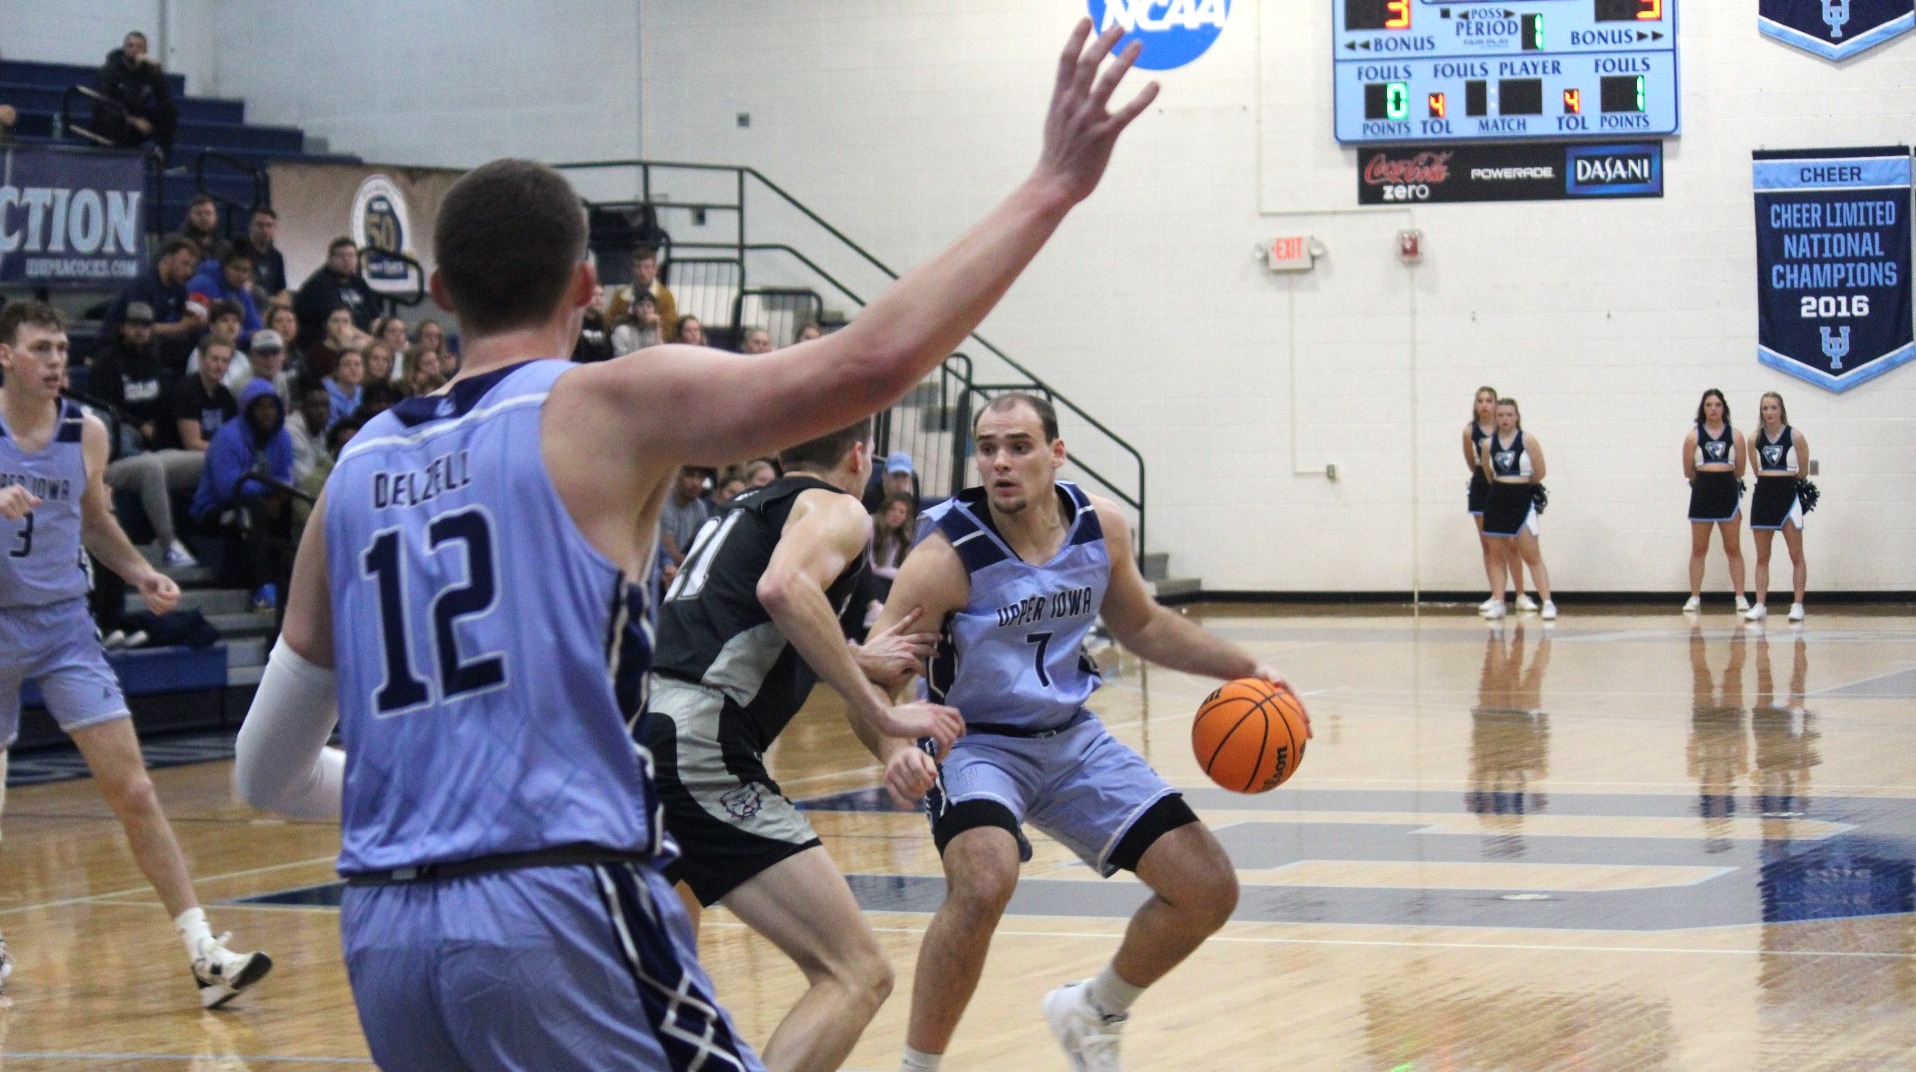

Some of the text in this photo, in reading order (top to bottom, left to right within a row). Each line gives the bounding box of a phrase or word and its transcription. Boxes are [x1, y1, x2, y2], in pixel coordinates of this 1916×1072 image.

[1101, 0, 1226, 33] NCAA
[1471, 8, 1501, 20] POSS
[1455, 20, 1518, 36] PERIOD
[1534, 14, 1543, 49] 1
[1570, 29, 1633, 45] BONUS
[1373, 36, 1435, 51] BONUS
[1357, 65, 1412, 80] FOULS
[1433, 60, 1562, 78] FOULS PLAYER
[1594, 57, 1650, 73] FOULS
[1387, 82, 1408, 120] 0
[1429, 93, 1445, 117] 4
[1565, 89, 1580, 114] 4
[1636, 75, 1645, 112] 1
[1362, 120, 1411, 135] POINTS
[1421, 119, 1453, 134] TOL
[1479, 118, 1527, 132] MATCH
[1557, 116, 1589, 131] TOL
[1600, 115, 1650, 128] POINTS
[1470, 167, 1553, 180] POWERADE
[1576, 157, 1649, 182] DASANI
[1800, 166, 1862, 183] CHEER
[1382, 184, 1430, 200] zero
[0, 185, 141, 254] CTION
[1770, 200, 1896, 229] CHEER LIMITED
[1276, 237, 1303, 260] EXIT
[1783, 232, 1884, 259] NATIONAL
[1771, 261, 1898, 290] CHAMPIONS
[1800, 295, 1869, 318] 2016
[10, 511, 33, 557] 3
[362, 505, 508, 717] 12
[997, 586, 1092, 628] UPPER IOWA
[1026, 632, 1053, 688] 7
